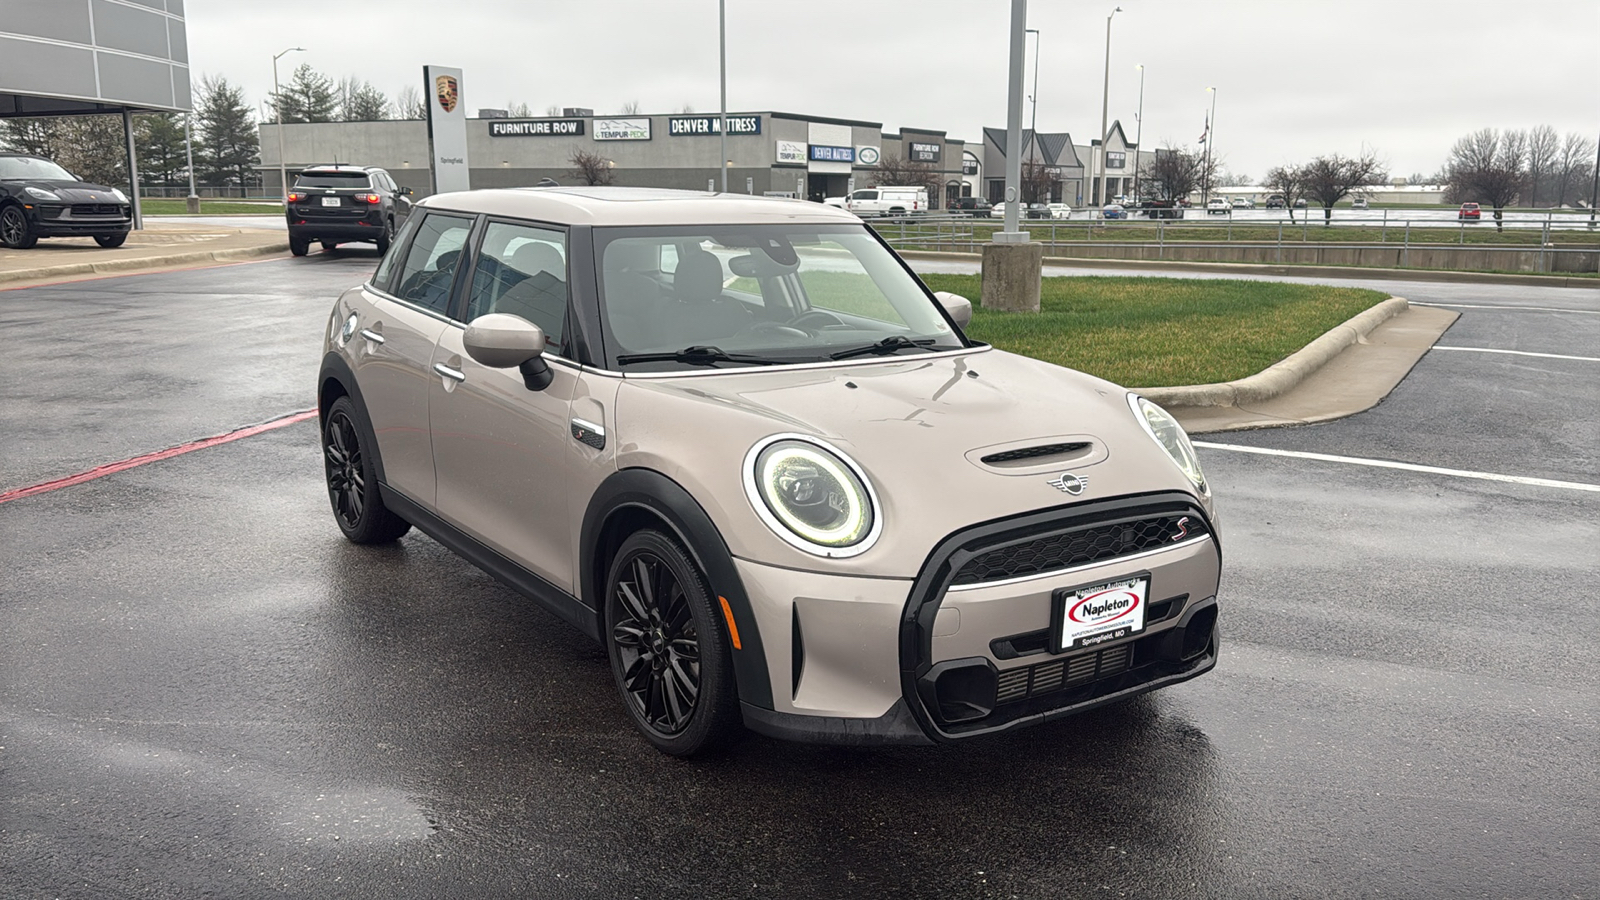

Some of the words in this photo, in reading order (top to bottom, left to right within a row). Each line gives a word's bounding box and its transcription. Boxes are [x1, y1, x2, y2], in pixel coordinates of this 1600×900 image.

[493, 122, 550, 134] FURNITURE
[552, 122, 577, 133] ROW
[672, 118, 709, 133] DENVER
[712, 118, 757, 132] MTTRESS
[814, 147, 832, 159] DENVER
[440, 157, 463, 165] Springfield
[1082, 599, 1129, 617] Napleton
[1115, 629, 1125, 638] MO
